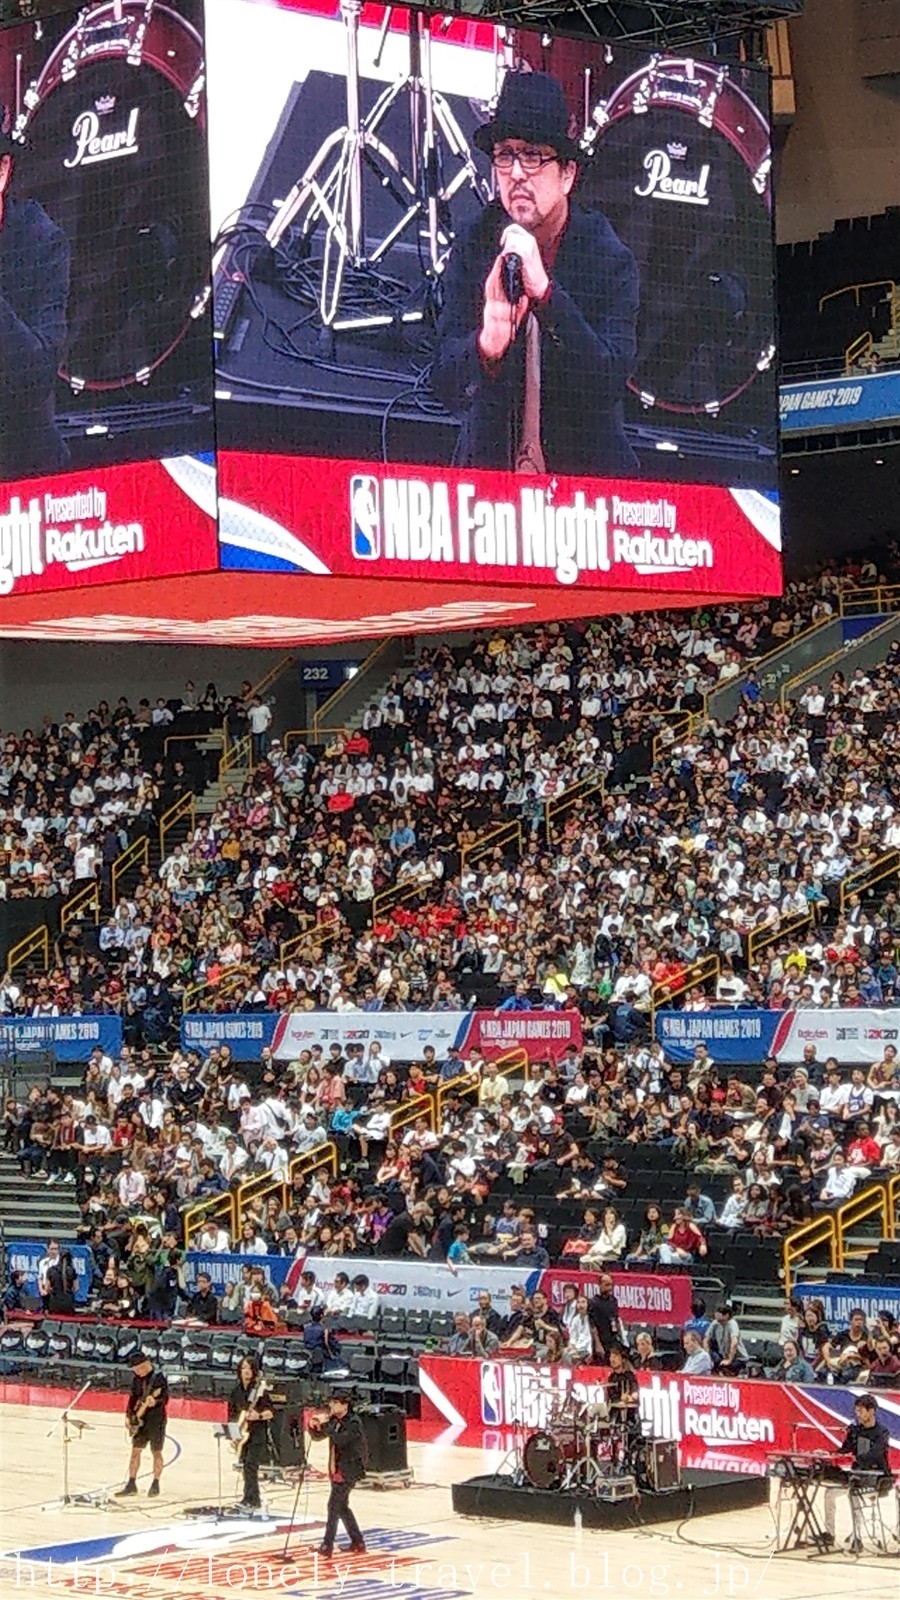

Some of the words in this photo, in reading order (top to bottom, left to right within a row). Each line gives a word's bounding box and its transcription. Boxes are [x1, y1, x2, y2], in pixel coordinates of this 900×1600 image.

[63, 107, 139, 168] Pearl
[634, 150, 710, 203] Pearl
[801, 389, 836, 409] GAMES
[834, 386, 863, 406] 2019
[44, 487, 93, 523] Presented
[93, 486, 106, 521] by
[612, 495, 663, 528] Presented
[664, 499, 677, 533] by
[46, 521, 144, 565] Rakuten
[382, 478, 454, 562] NBA
[457, 484, 518, 566] Fan
[521, 486, 610, 585] Night
[613, 529, 714, 570] Rakuten
[303, 667, 328, 680] 232
[687, 1018, 713, 1039] JAPAN
[713, 1018, 740, 1039] GAMES
[740, 1018, 761, 1039] 2019
[377, 1282, 407, 1296] 2K20
[647, 1286, 672, 1312] 2019
[683, 1379, 729, 1408] Presented
[728, 1383, 741, 1413] by
[684, 1407, 776, 1443] Rakuten
